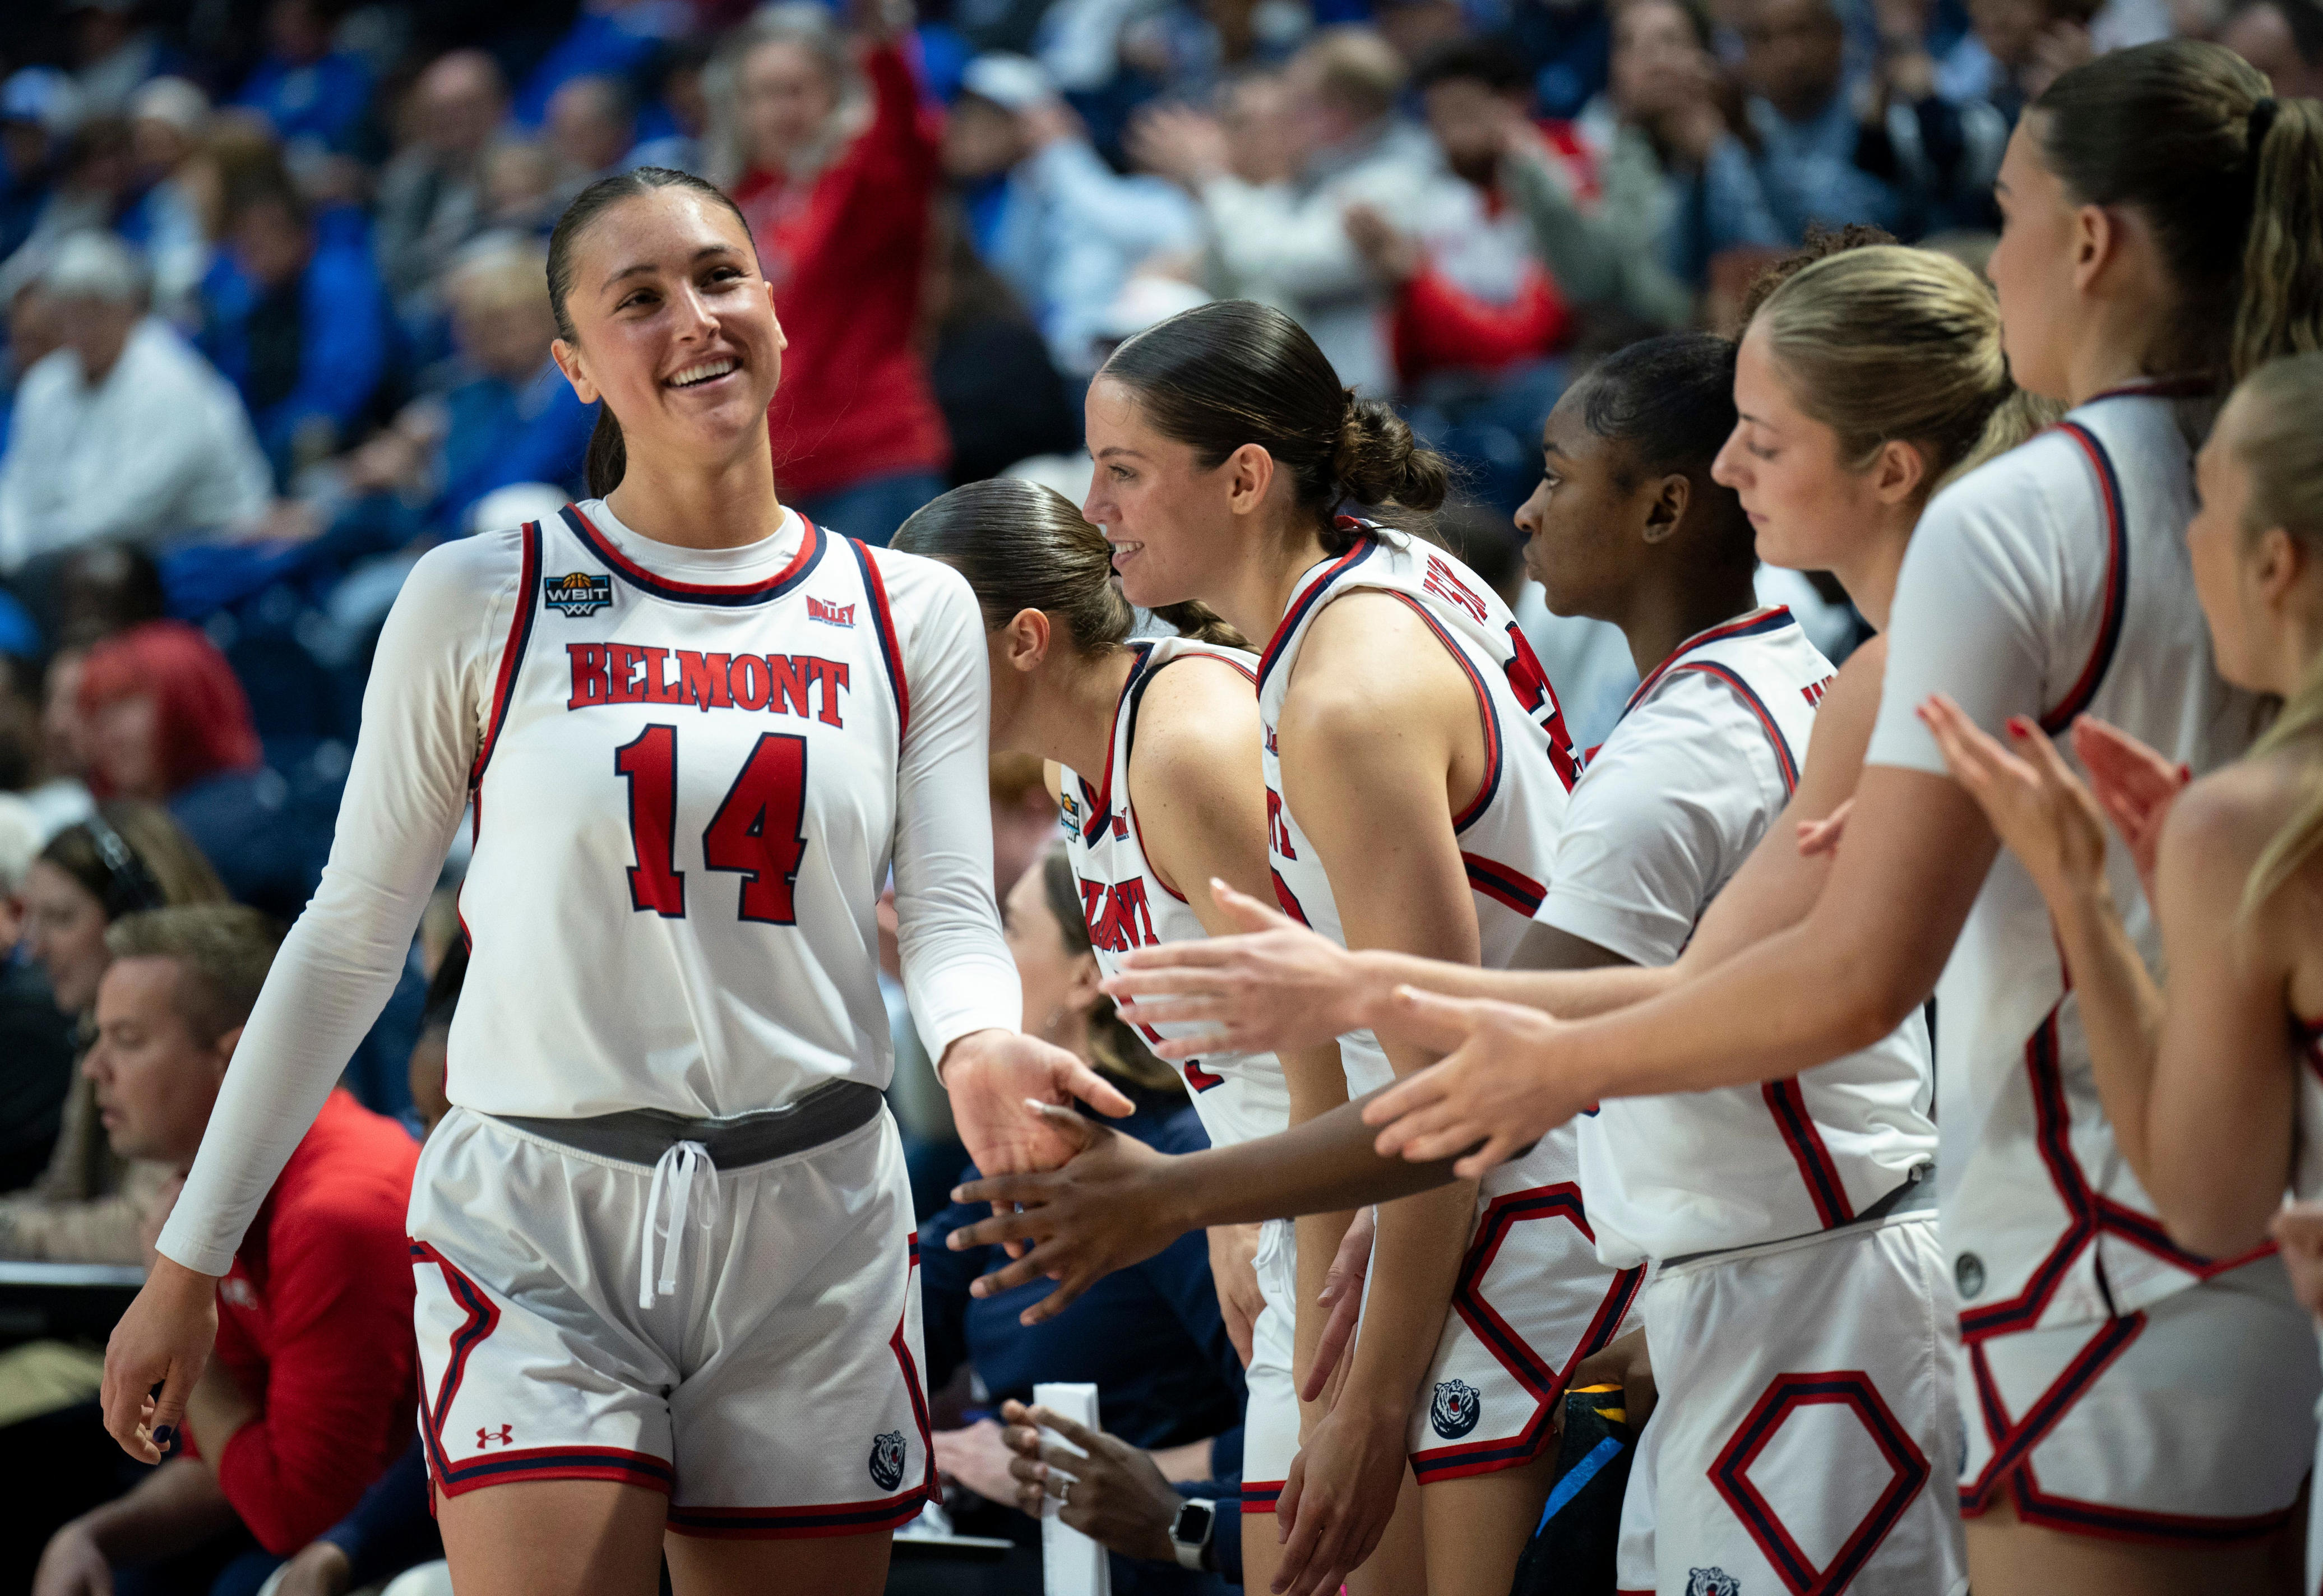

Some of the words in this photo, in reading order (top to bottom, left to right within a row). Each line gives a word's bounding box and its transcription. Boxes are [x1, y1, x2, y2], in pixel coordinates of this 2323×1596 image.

[547, 588, 609, 602] WBIT
[806, 595, 855, 625] VALLEY
[566, 642, 850, 730] BELMONT
[615, 723, 808, 926] 14
